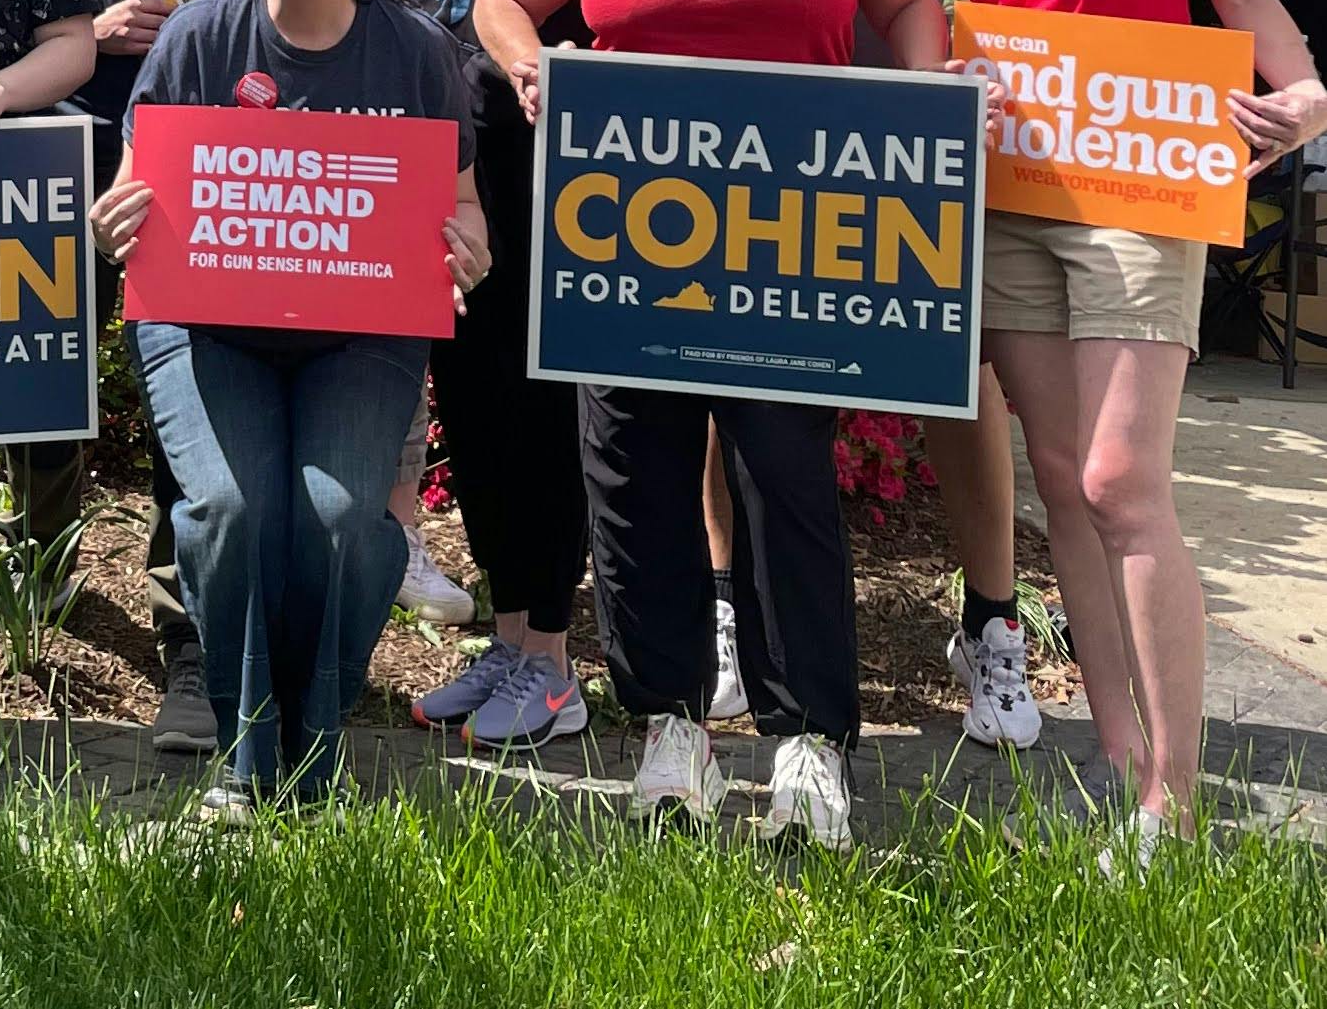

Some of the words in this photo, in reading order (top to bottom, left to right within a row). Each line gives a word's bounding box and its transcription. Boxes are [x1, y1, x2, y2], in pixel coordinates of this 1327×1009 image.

[974, 32, 1006, 49] we
[1009, 36, 1049, 54] can
[1087, 71, 1219, 127] gun
[193, 144, 322, 180] MOMS
[559, 111, 773, 173] LAURA
[797, 129, 965, 187] JANE
[997, 100, 1238, 186] iolence
[191, 180, 375, 218] DEMAND
[1012, 165, 1198, 212] wearorange.org
[189, 215, 349, 253] ACTION
[554, 172, 964, 289] COHEN
[189, 252, 218, 268] FOR
[222, 254, 253, 270] GUN
[257, 257, 303, 274] SENSE
[307, 259, 322, 274] IN
[326, 260, 394, 279] AMERICA
[555, 270, 641, 306] FOR
[729, 284, 962, 333] DELEGATE
[765, 356, 789, 365] LAURA
[789, 358, 806, 367] JANE
[807, 359, 832, 369] COHEN
